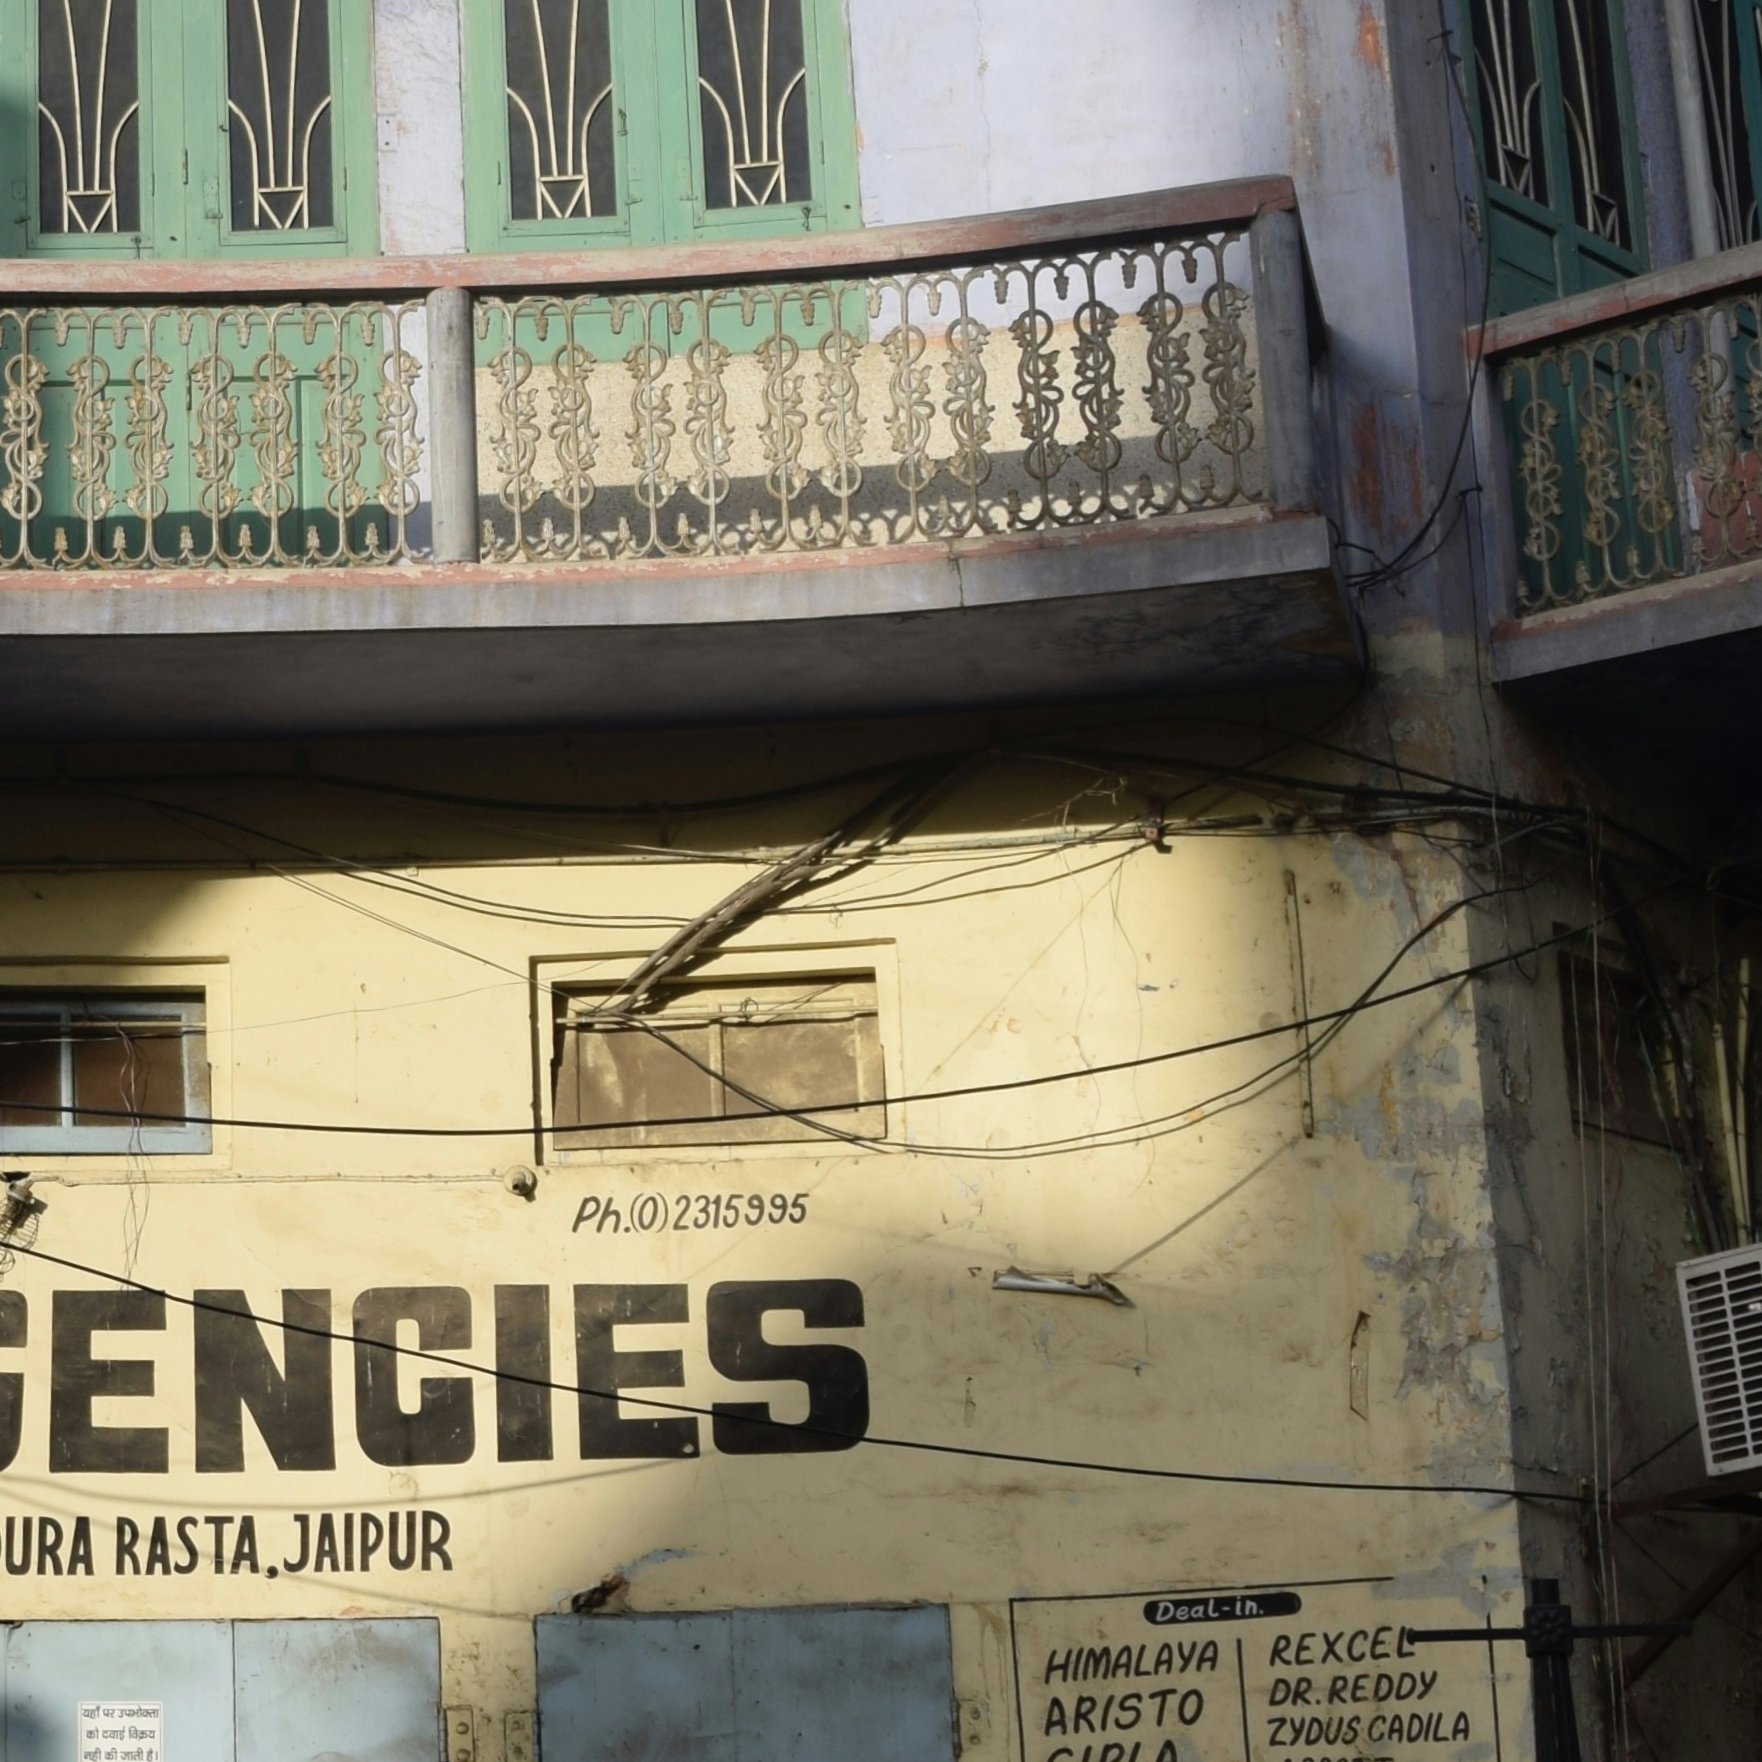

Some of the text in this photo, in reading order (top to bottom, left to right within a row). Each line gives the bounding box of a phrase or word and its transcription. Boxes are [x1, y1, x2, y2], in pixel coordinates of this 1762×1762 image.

[1269, 1626, 1415, 1667] REXCEL
[1045, 1640, 1219, 1685] HIMALAYA
[103, 1708, 115, 1718] पर
[1044, 1689, 1204, 1736] ARISTO
[87, 1727, 99, 1740] को
[102, 1726, 125, 1740] दवाई
[105, 1748, 117, 1760] की
[120, 1748, 144, 1761] जाती
